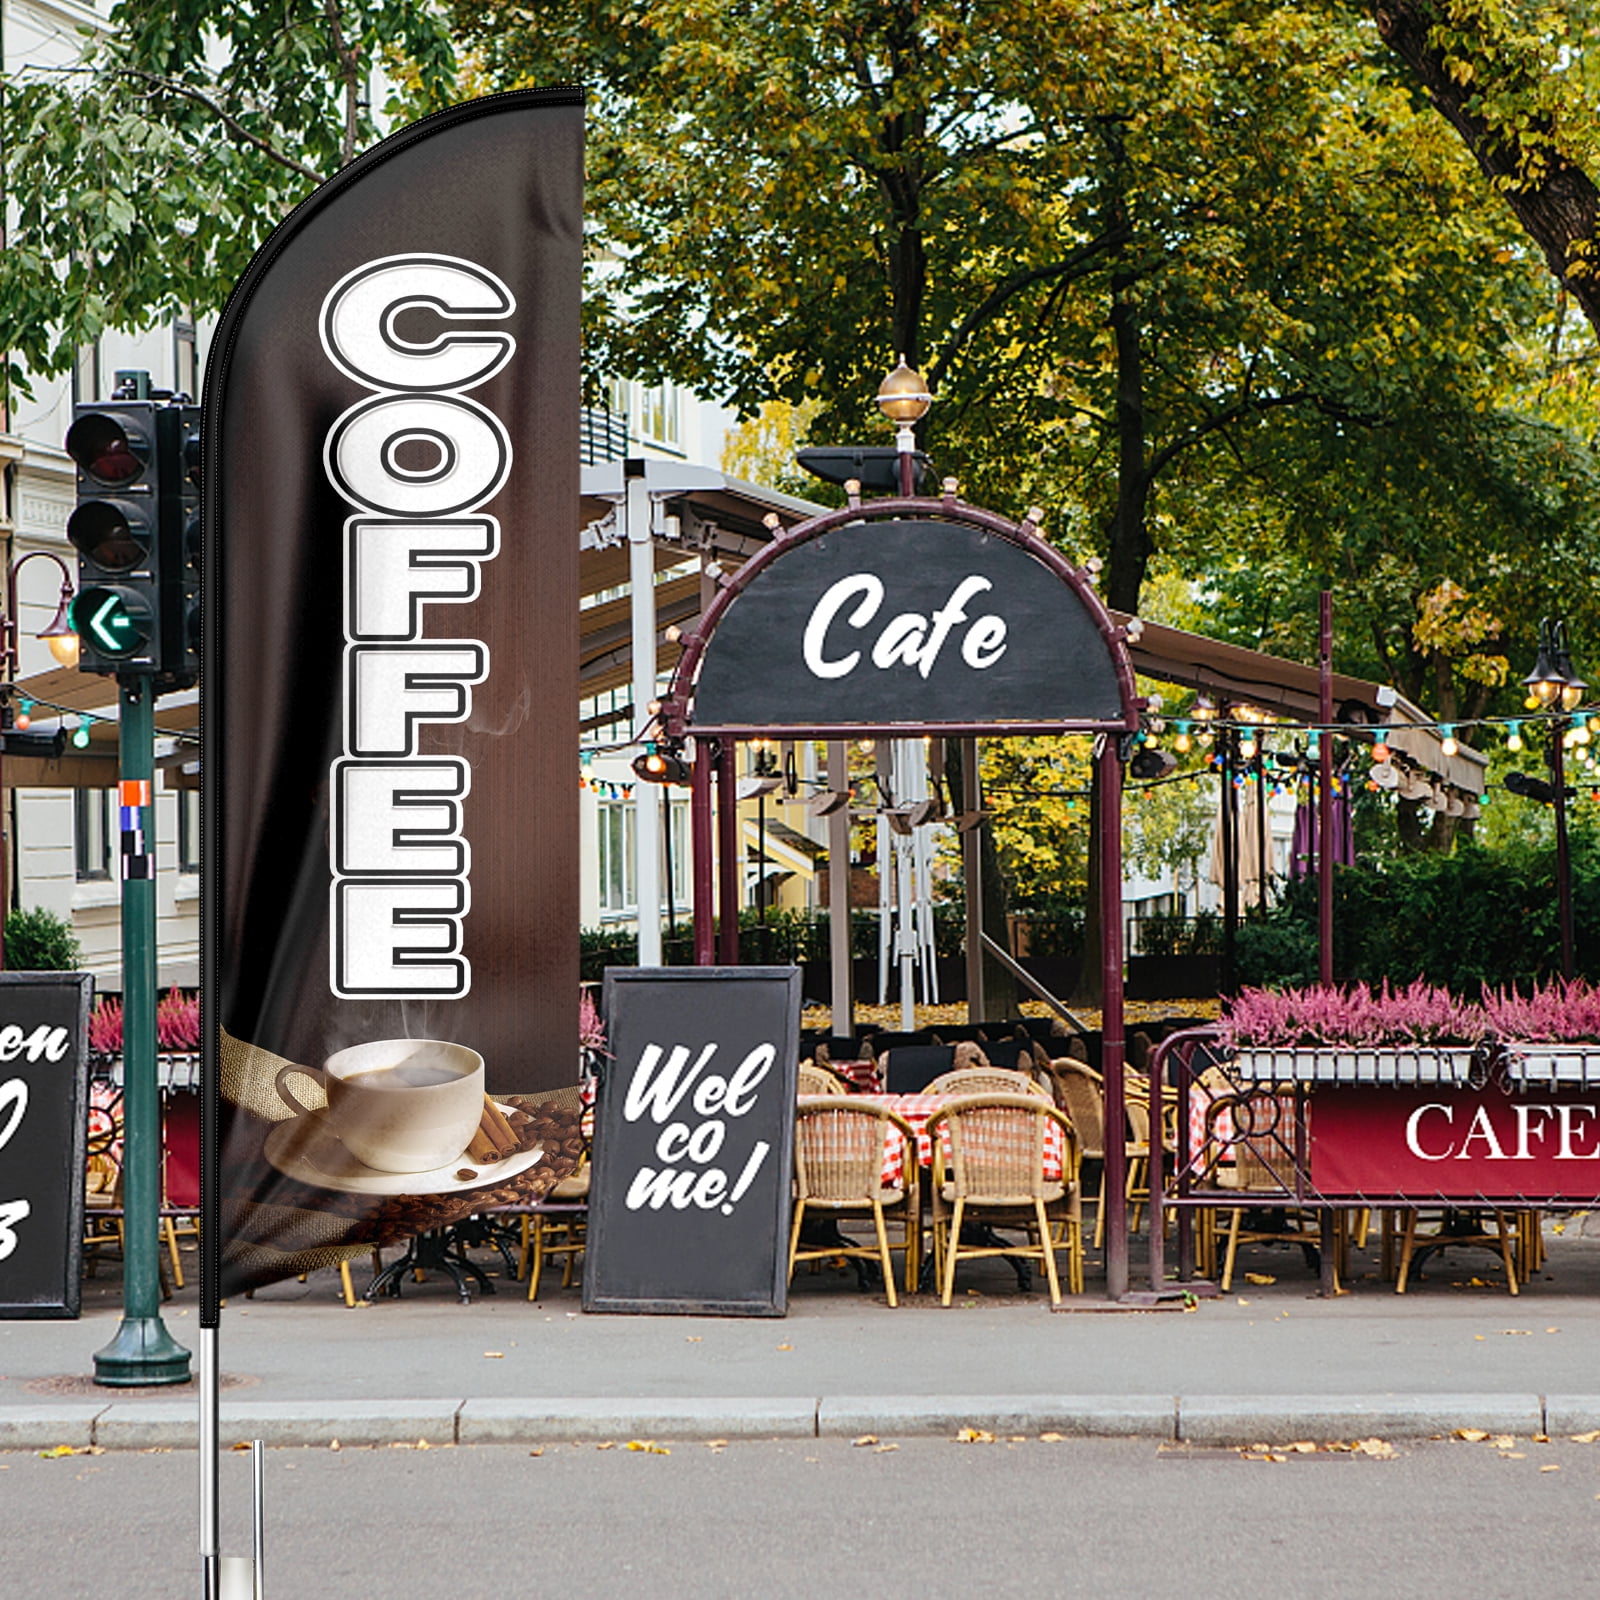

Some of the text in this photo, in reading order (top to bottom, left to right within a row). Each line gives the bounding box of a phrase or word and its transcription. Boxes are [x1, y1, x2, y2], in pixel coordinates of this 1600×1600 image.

[318, 252, 517, 1001] COFFEE
[803, 573, 1007, 680] Cafe
[624, 1043, 776, 1123] Wel
[656, 1120, 726, 1164] co
[1406, 1103, 1600, 1160] CAFE
[625, 1141, 771, 1216] me!
